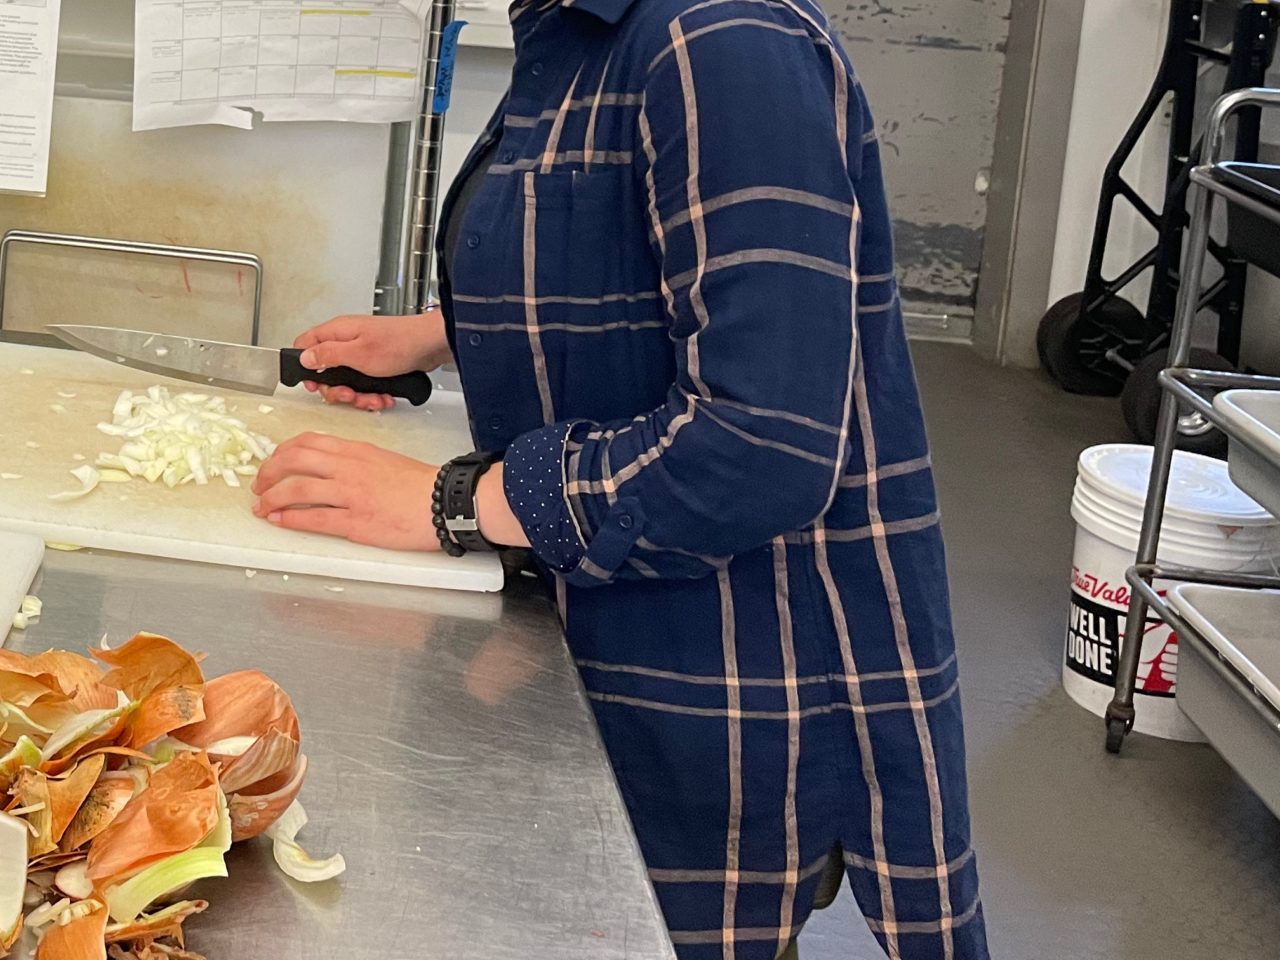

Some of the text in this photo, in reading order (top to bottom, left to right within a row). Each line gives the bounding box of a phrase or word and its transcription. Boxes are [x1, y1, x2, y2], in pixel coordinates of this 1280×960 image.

[1084, 573, 1132, 606] Val
[1069, 601, 1112, 646] WELL
[1068, 630, 1113, 676] DONE
